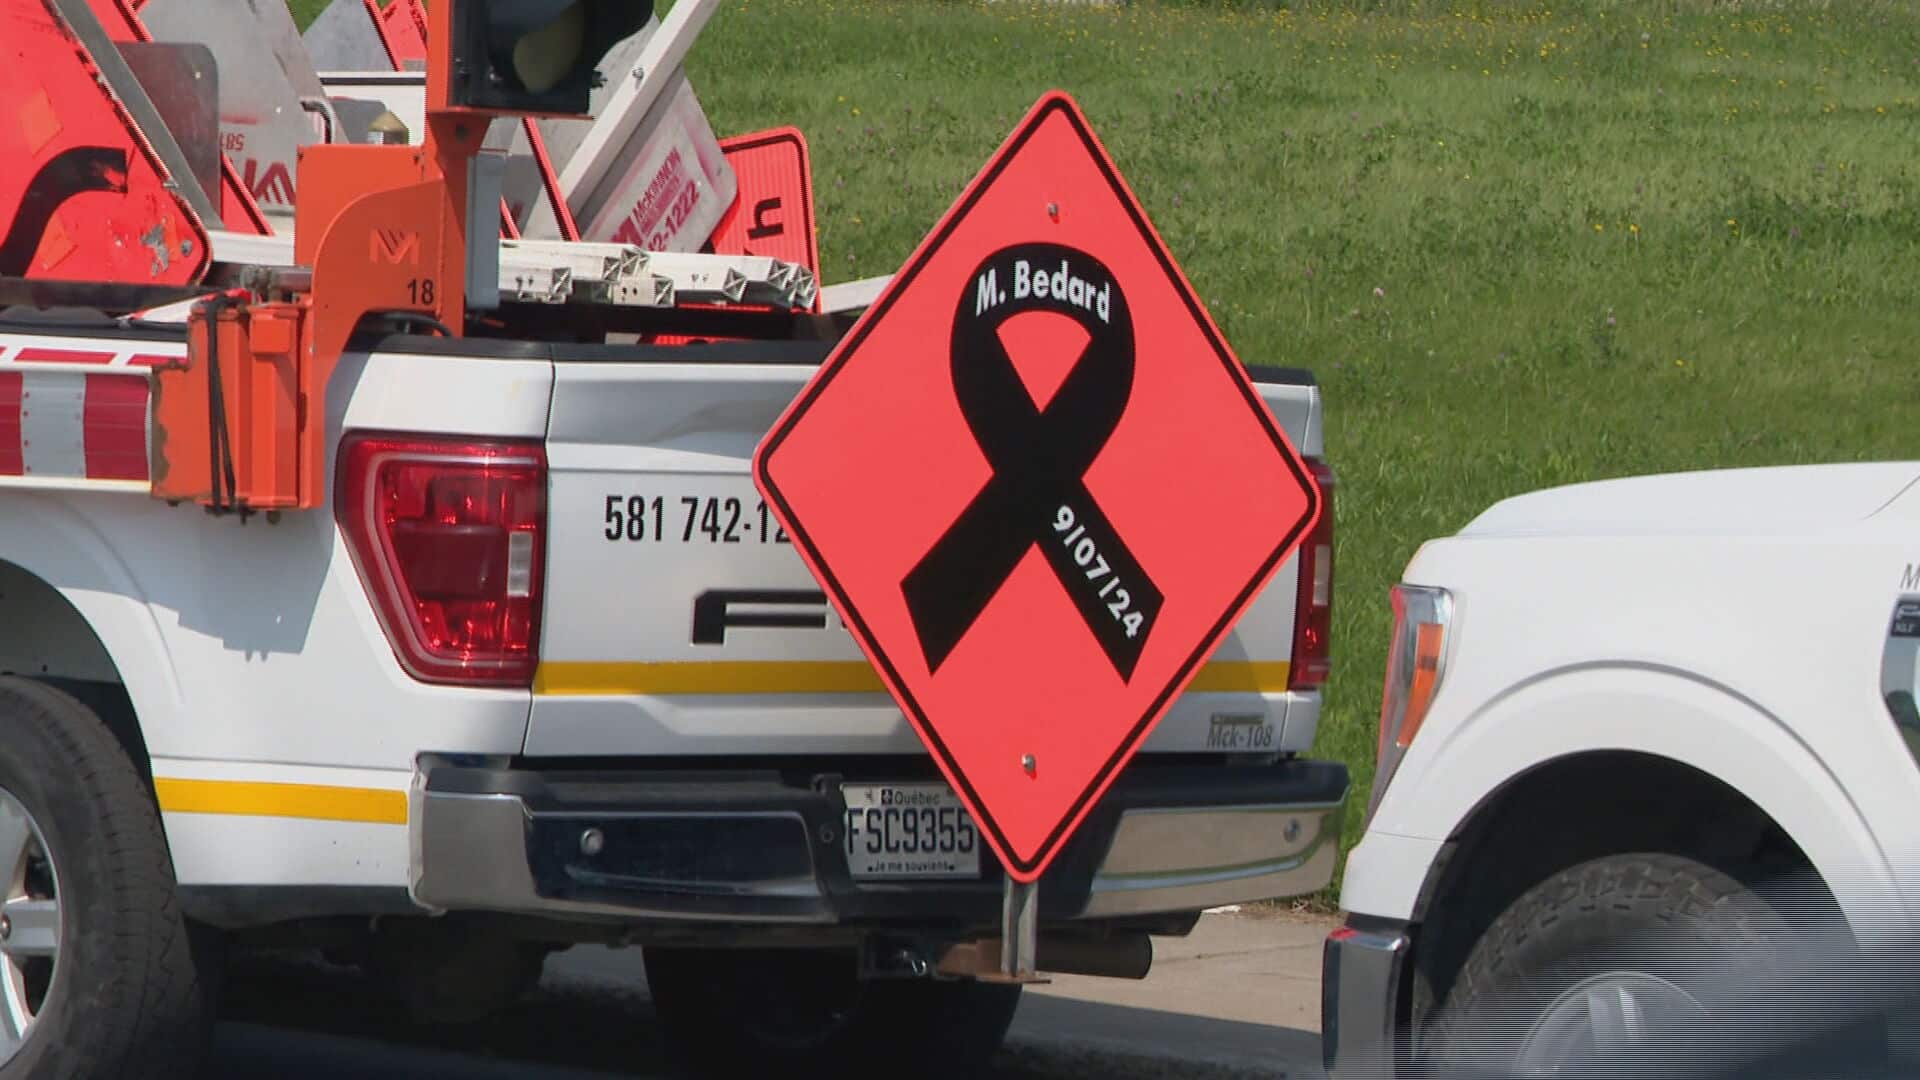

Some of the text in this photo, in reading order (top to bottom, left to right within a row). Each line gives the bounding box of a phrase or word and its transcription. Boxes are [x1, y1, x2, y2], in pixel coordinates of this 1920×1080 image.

[407, 278, 434, 306] 18
[975, 259, 1111, 324] M. Bedard
[604, 495, 664, 542] 581
[894, 789, 941, 805] Québec
[847, 807, 974, 855] FSC9355
